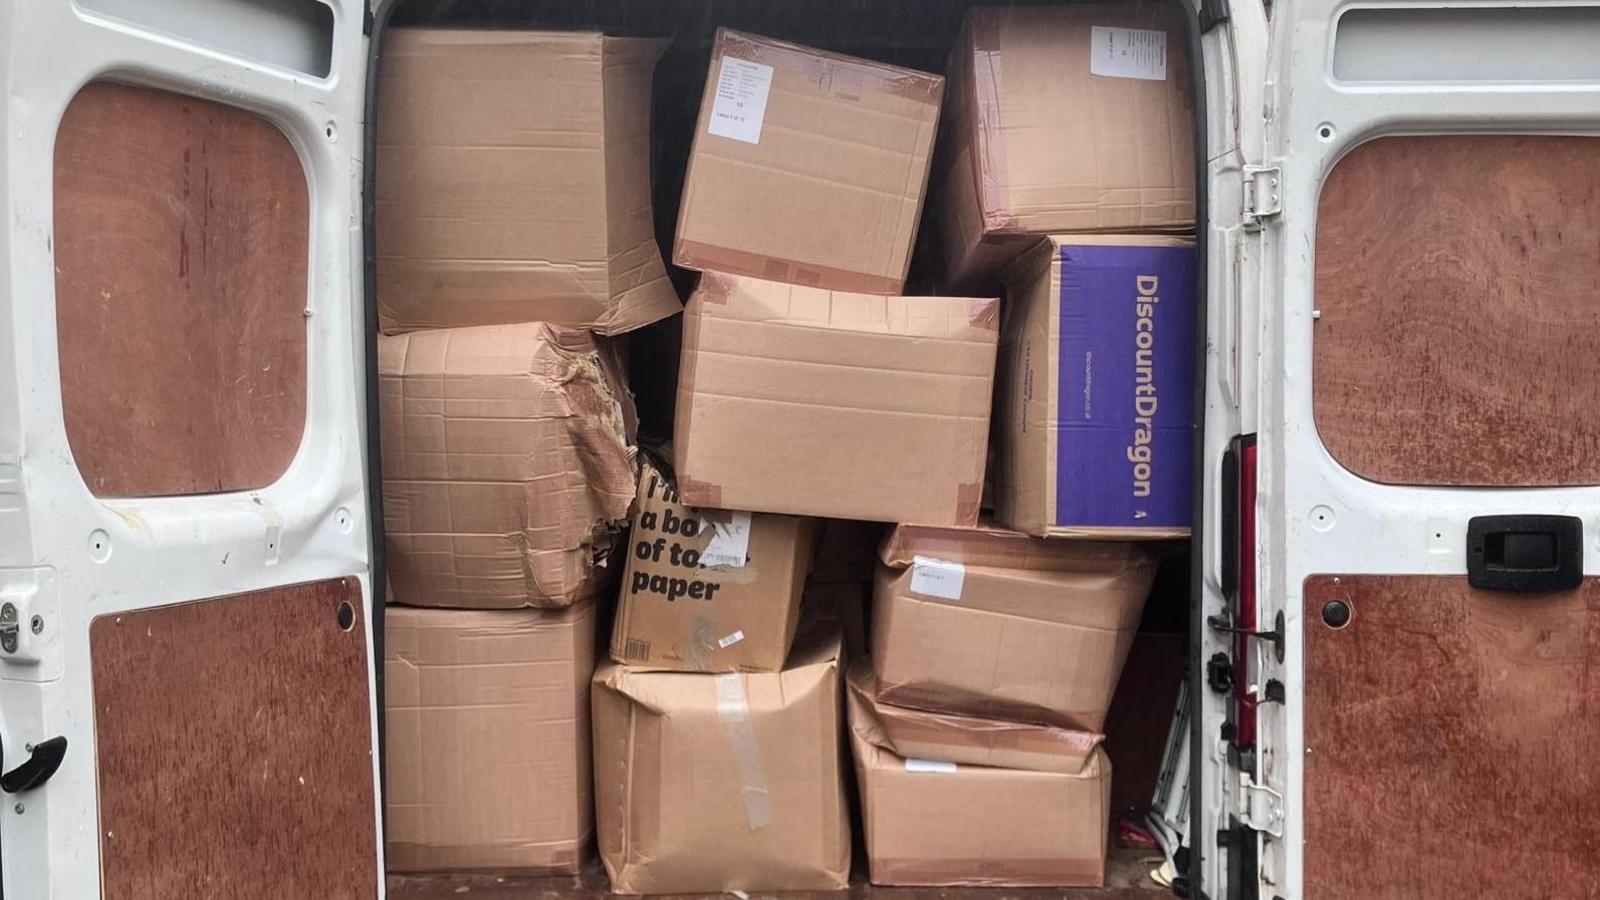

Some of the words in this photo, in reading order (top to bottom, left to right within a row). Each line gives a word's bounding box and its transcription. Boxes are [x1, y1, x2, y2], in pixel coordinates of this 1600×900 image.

[1127, 275, 1159, 497] DiscountDragon
[641, 511, 657, 530] a
[662, 509, 700, 537] bo
[636, 538, 667, 562] of
[631, 571, 720, 602] paper
